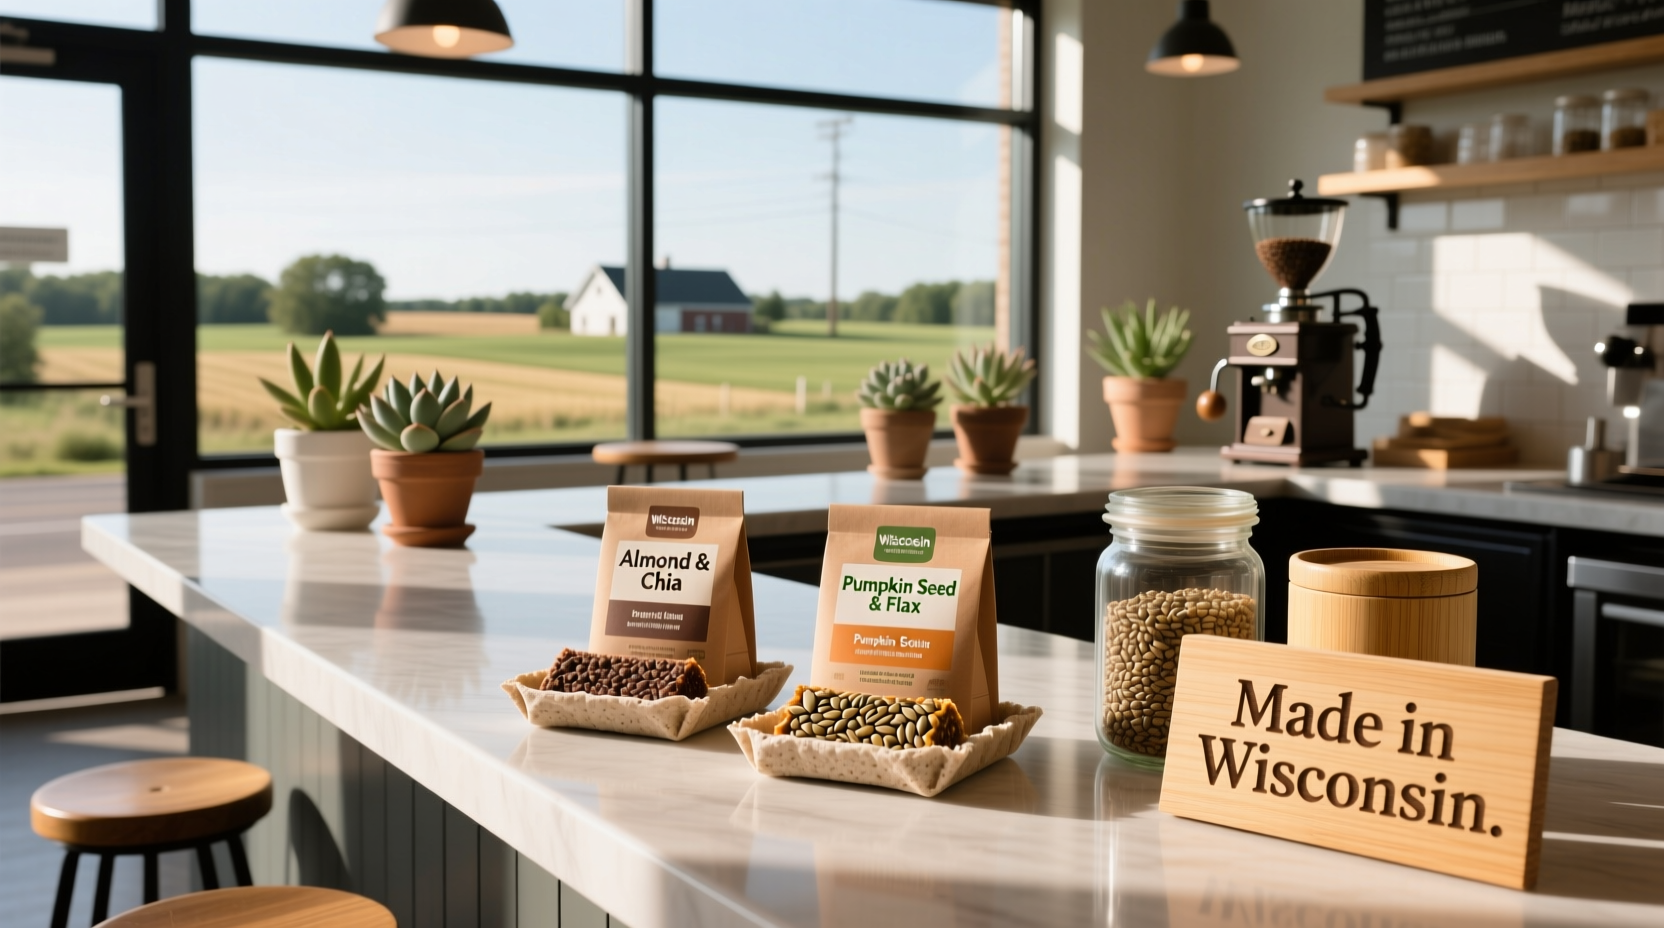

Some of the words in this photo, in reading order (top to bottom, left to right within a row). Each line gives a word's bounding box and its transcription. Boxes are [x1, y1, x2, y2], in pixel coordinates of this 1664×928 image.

[619, 549, 692, 570] Almond
[695, 552, 710, 571] &
[641, 571, 682, 591] Chia
[842, 575, 913, 597] Pumpkin
[917, 578, 957, 597] Seed
[869, 595, 882, 611] &
[886, 596, 921, 614] Flax
[1230, 678, 1384, 749] Made
[1397, 702, 1455, 761] in
[1198, 734, 1503, 838] Wisconsin.
